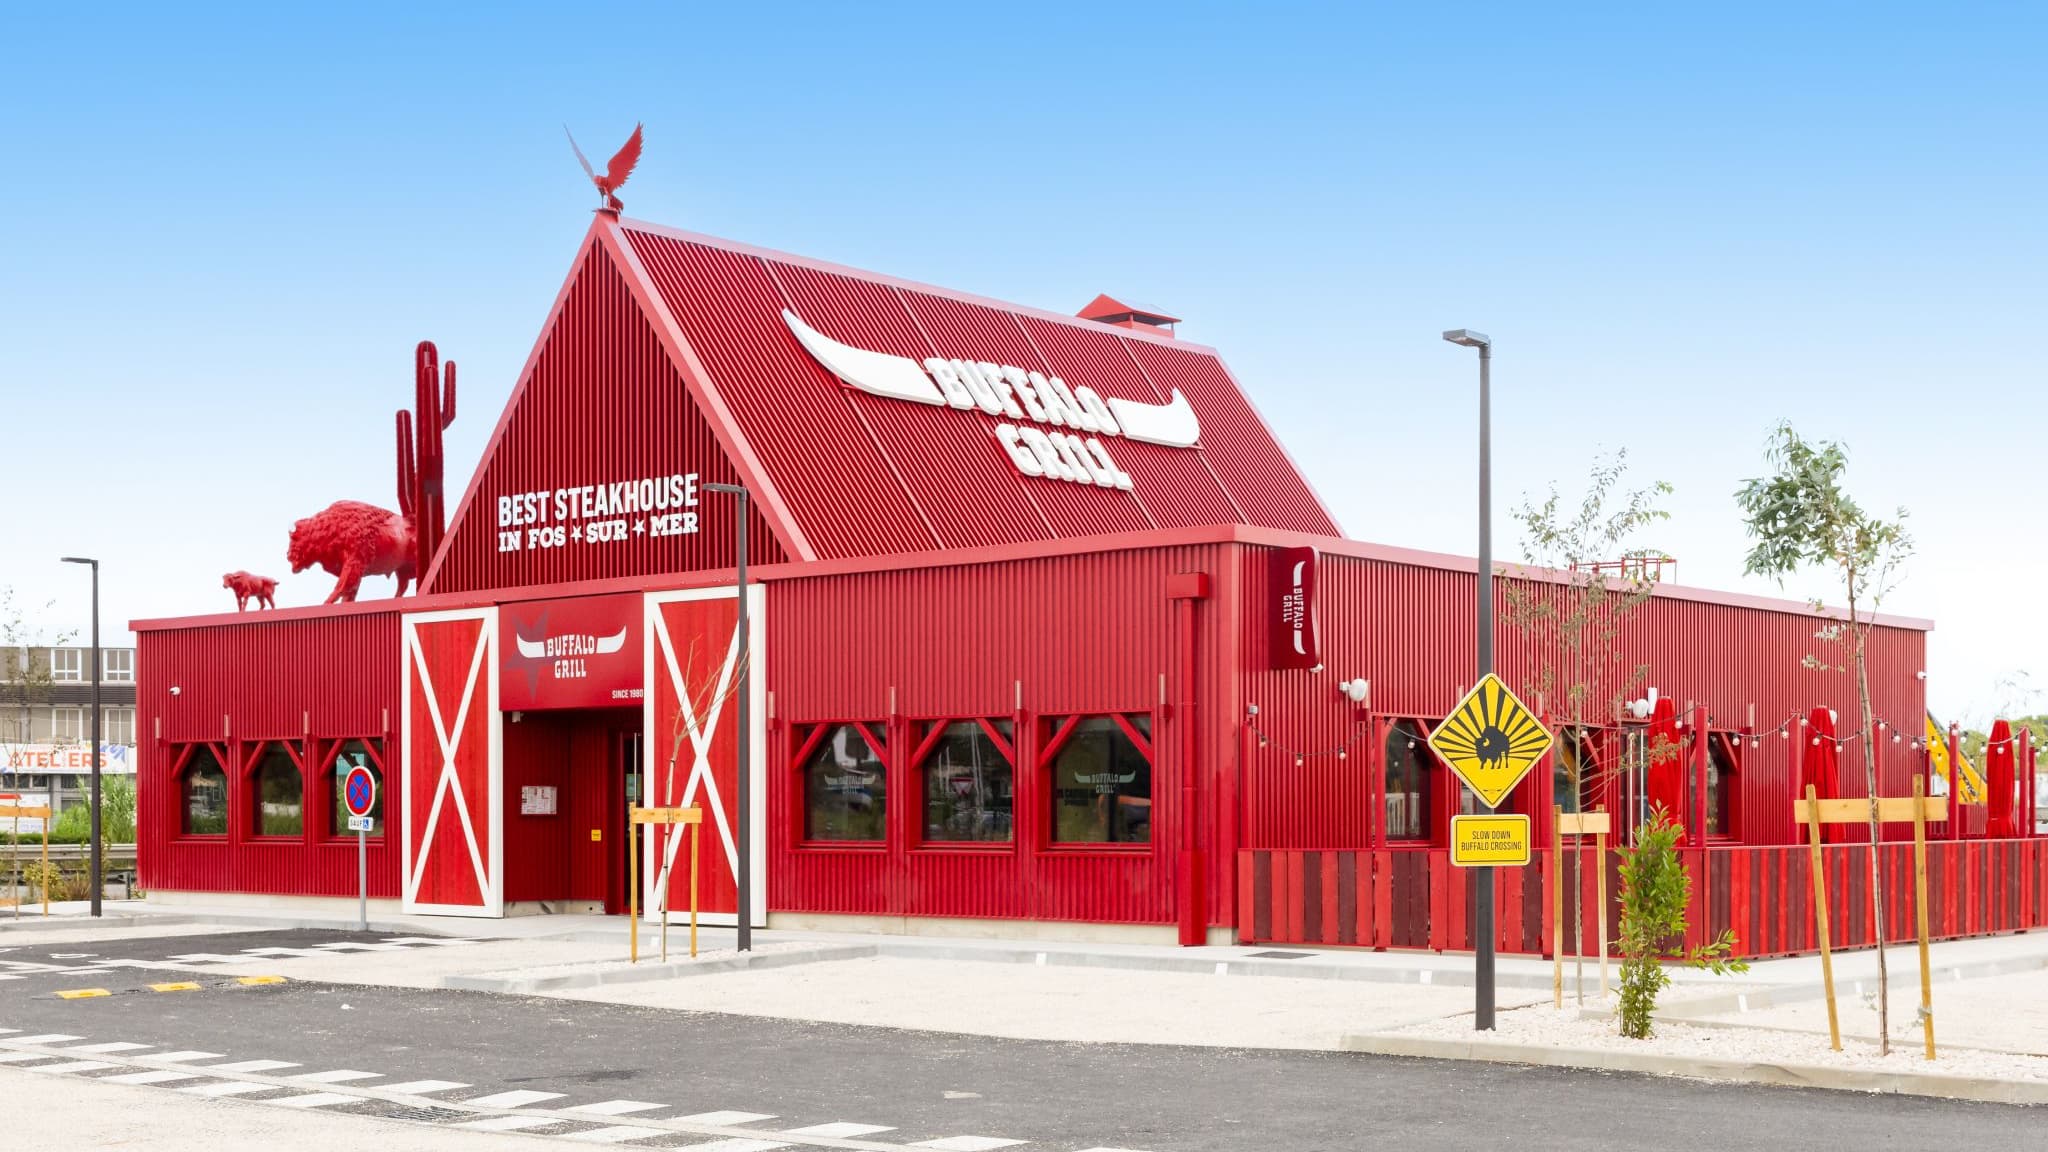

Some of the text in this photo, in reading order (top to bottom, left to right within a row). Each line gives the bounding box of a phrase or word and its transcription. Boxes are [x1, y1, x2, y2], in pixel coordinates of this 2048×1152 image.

[922, 357, 1121, 436] BUFFALO
[995, 423, 1133, 490] GRILL
[498, 473, 699, 527] BEST STEAKHOUSE
[498, 512, 698, 552] IN FOS SUR MER
[1283, 595, 1293, 623] GRILL
[1294, 587, 1304, 629] BUFFALO
[546, 634, 595, 657] BUFFALO
[554, 658, 587, 679] GRILL
[611, 688, 644, 699] SINCE 1980
[1091, 773, 1119, 784] BUFFALO
[1095, 784, 1115, 793] GRILL
[1461, 841, 1522, 852] BUFFALO CROSSING
[1472, 830, 1511, 840] SLOW DOWN
